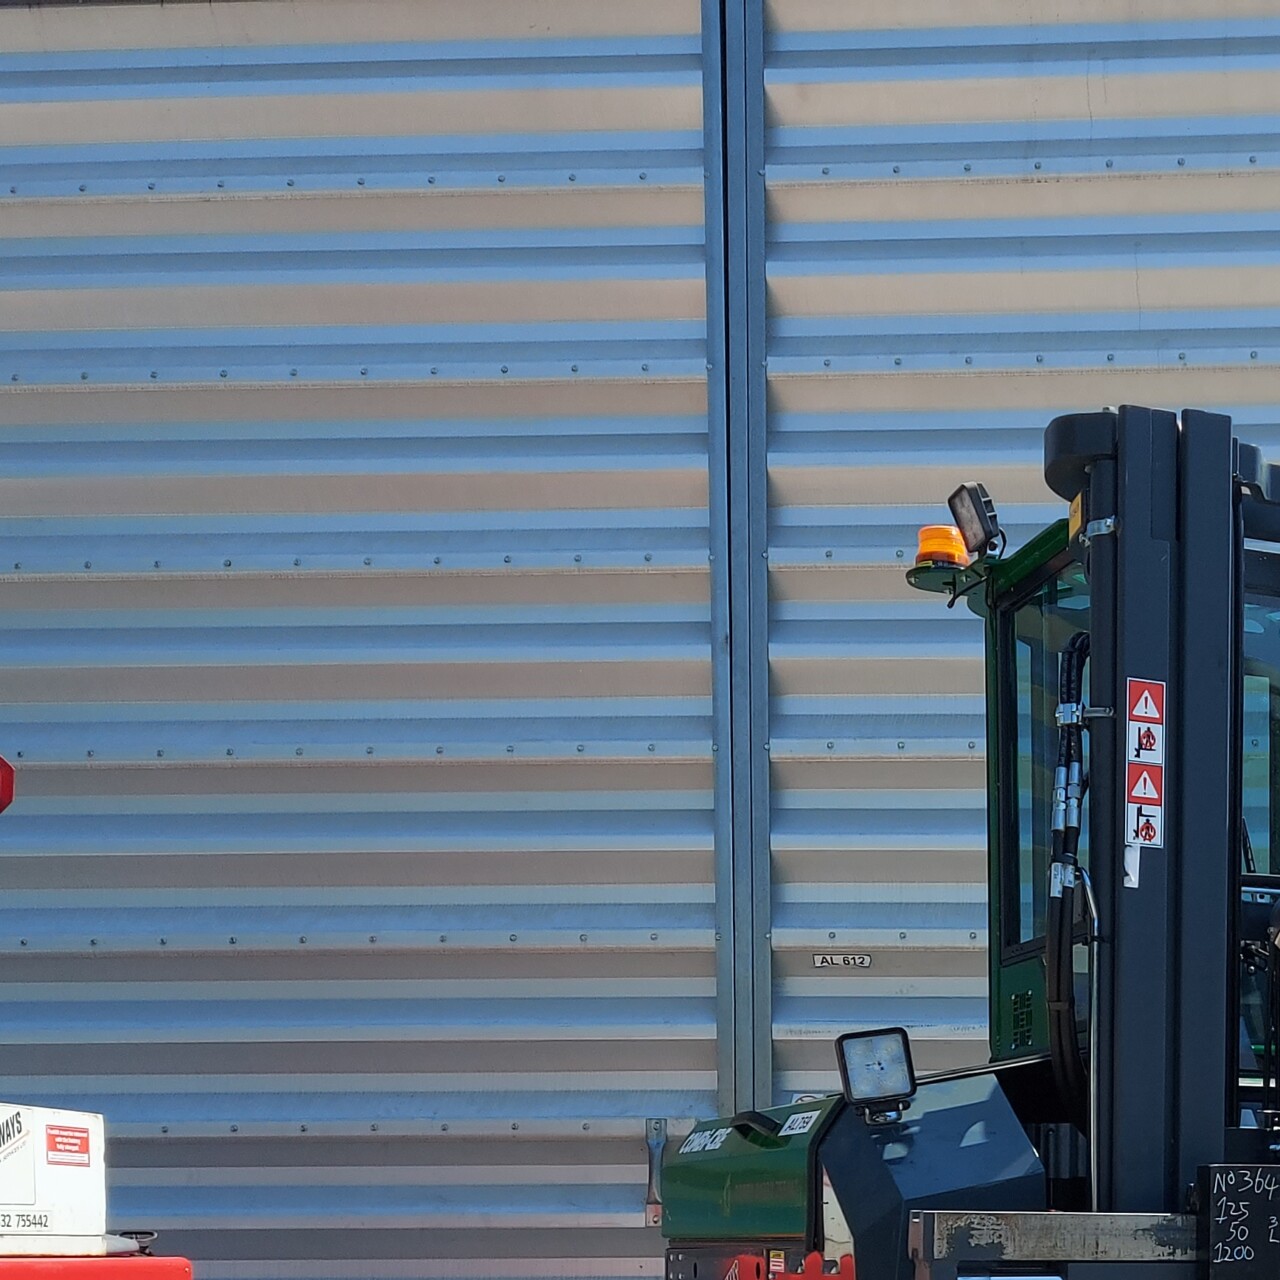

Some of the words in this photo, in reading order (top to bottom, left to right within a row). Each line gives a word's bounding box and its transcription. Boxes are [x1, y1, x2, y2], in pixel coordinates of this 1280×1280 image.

[820, 956, 839, 966] AL
[842, 956, 865, 966] 612
[1214, 1196, 1250, 1224] 125
[15, 1213, 49, 1229] 755442
[1225, 1221, 1249, 1242] 50
[1213, 1242, 1255, 1263] 1200
